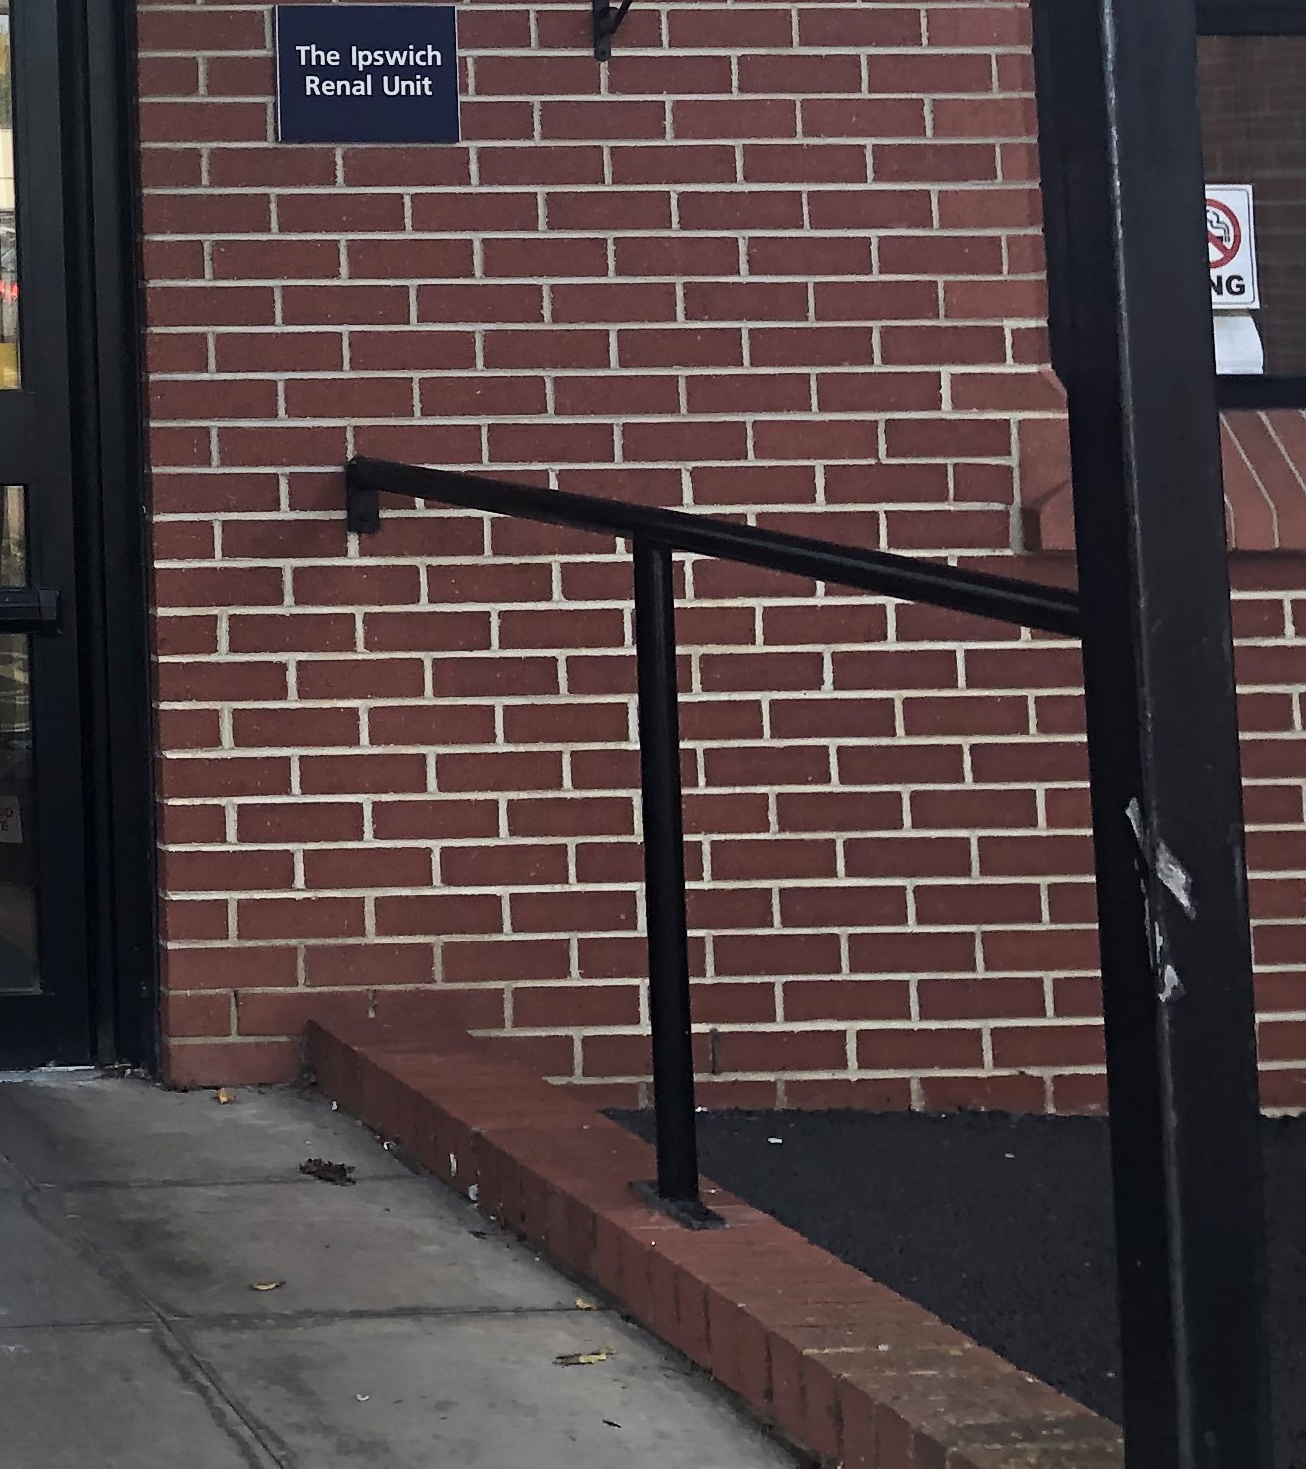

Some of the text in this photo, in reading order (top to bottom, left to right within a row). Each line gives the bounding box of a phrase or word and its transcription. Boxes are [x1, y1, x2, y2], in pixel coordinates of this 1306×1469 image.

[295, 43, 442, 72] The Ipswich
[305, 74, 433, 96] Renal Unit
